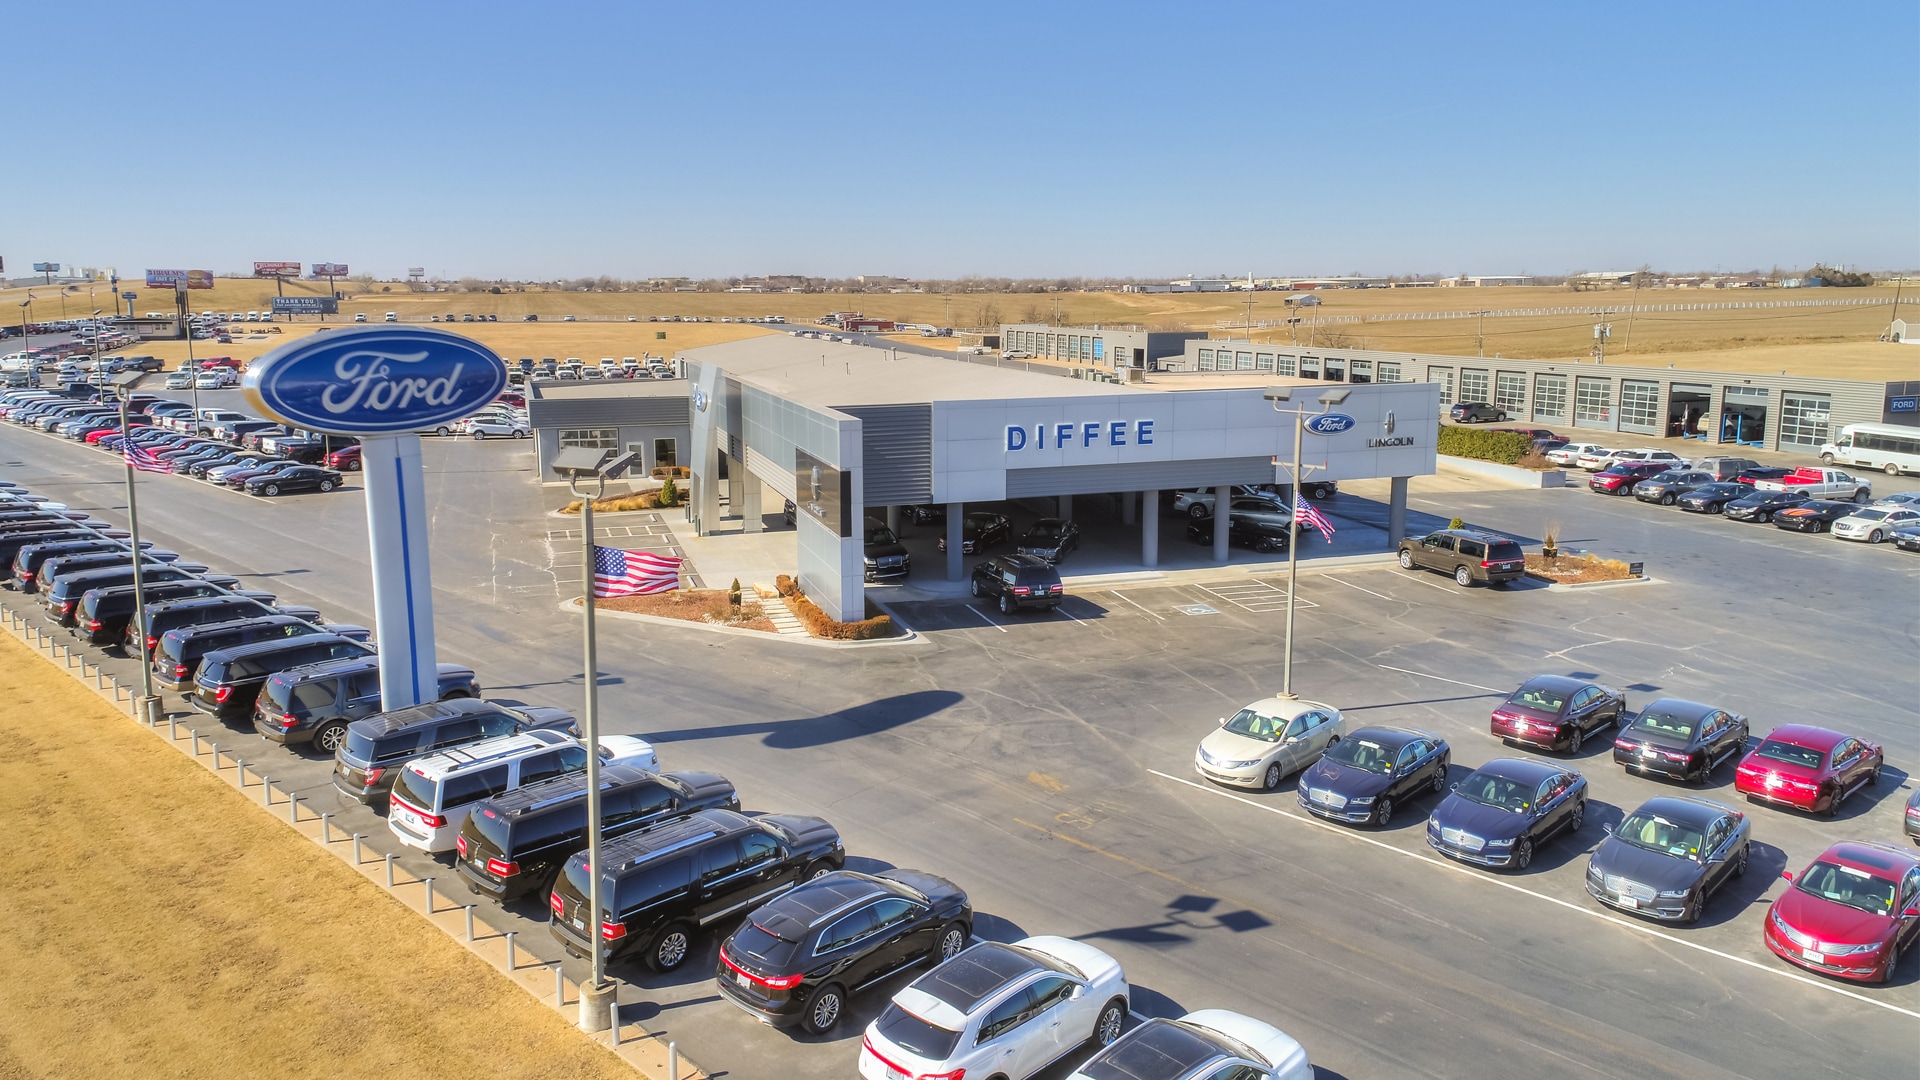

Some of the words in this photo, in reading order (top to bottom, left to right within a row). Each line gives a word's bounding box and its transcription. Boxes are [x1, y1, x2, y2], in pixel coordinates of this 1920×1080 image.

[321, 351, 464, 414] Ford
[1893, 400, 1914, 409] FORD
[1317, 417, 1346, 431] Ford
[1006, 420, 1154, 451] DIFFEE
[1367, 437, 1414, 448] LINCOLN
